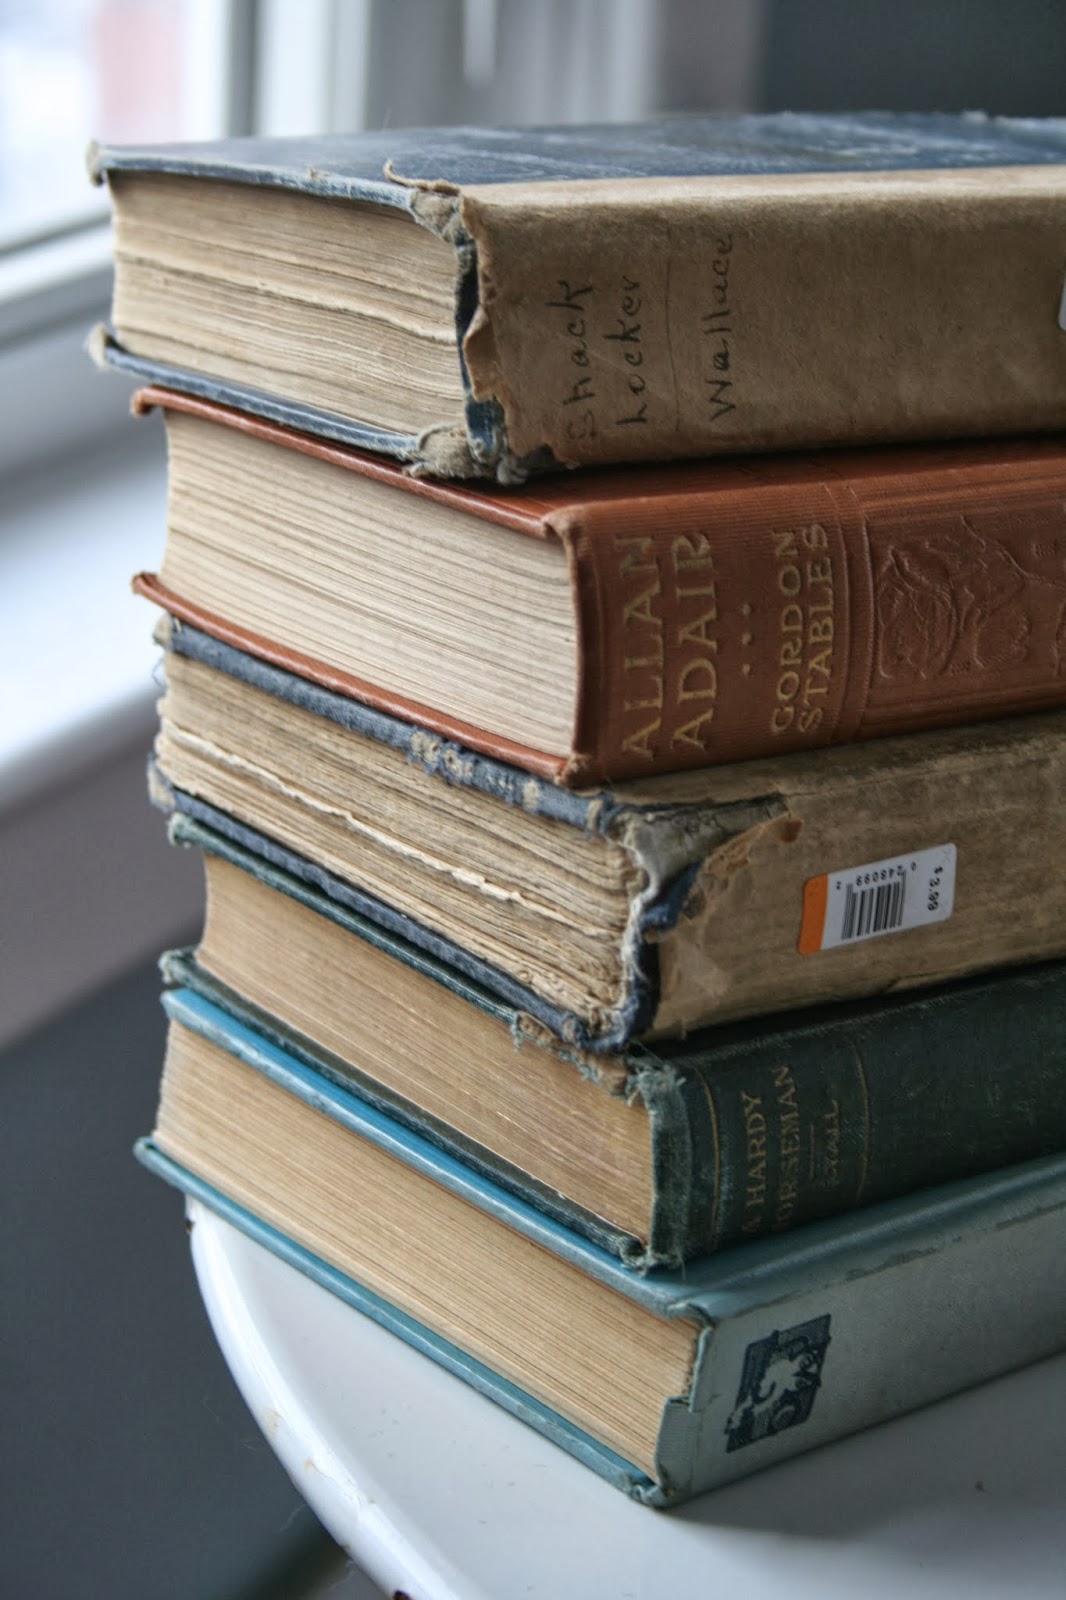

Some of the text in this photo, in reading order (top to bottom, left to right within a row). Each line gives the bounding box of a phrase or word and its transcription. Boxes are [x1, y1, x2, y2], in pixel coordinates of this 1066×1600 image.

[545, 280, 597, 439] Shack
[702, 234, 736, 421] Wallace
[614, 535, 665, 761] ALLAN
[670, 533, 718, 752] ADAIR
[771, 531, 803, 735] GORDON
[799, 523, 834, 732] STABLES
[741, 1090, 767, 1206] HARDY
